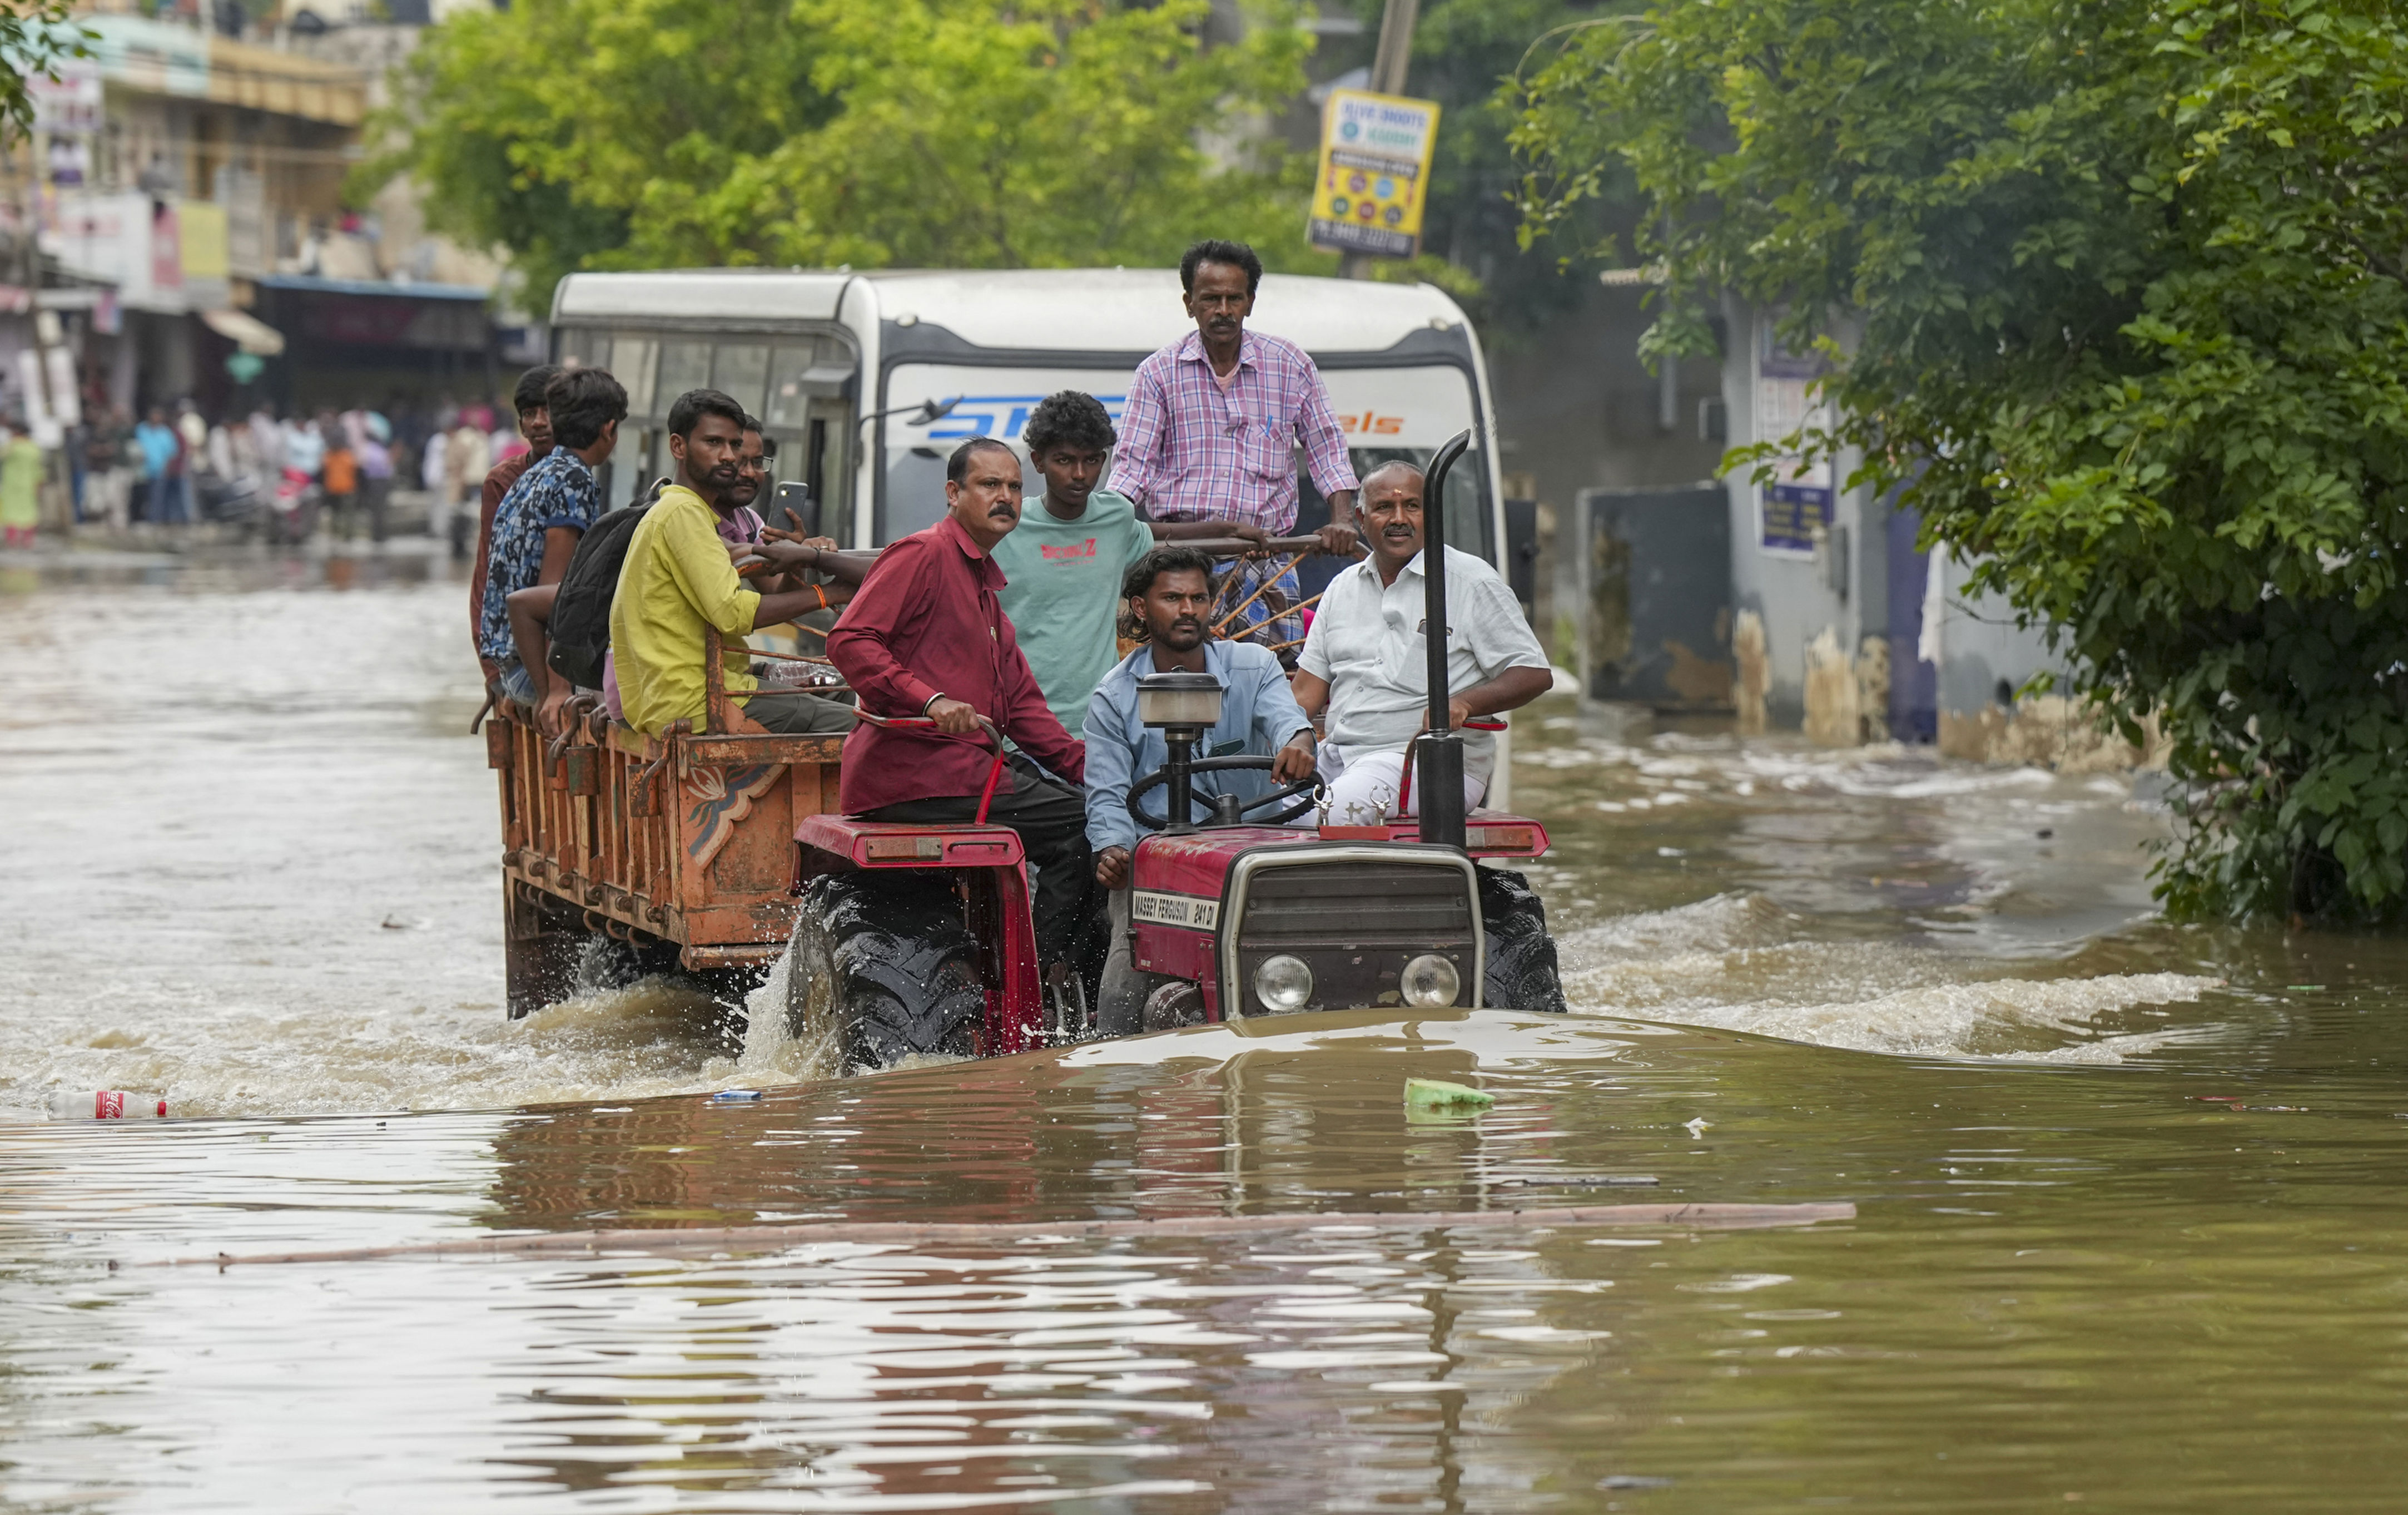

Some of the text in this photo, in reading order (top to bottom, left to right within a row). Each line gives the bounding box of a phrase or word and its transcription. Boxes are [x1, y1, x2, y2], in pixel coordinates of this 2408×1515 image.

[1085, 538, 1096, 557] Z
[1134, 895, 1215, 926] MASSEY FERGUSON 241 DI
